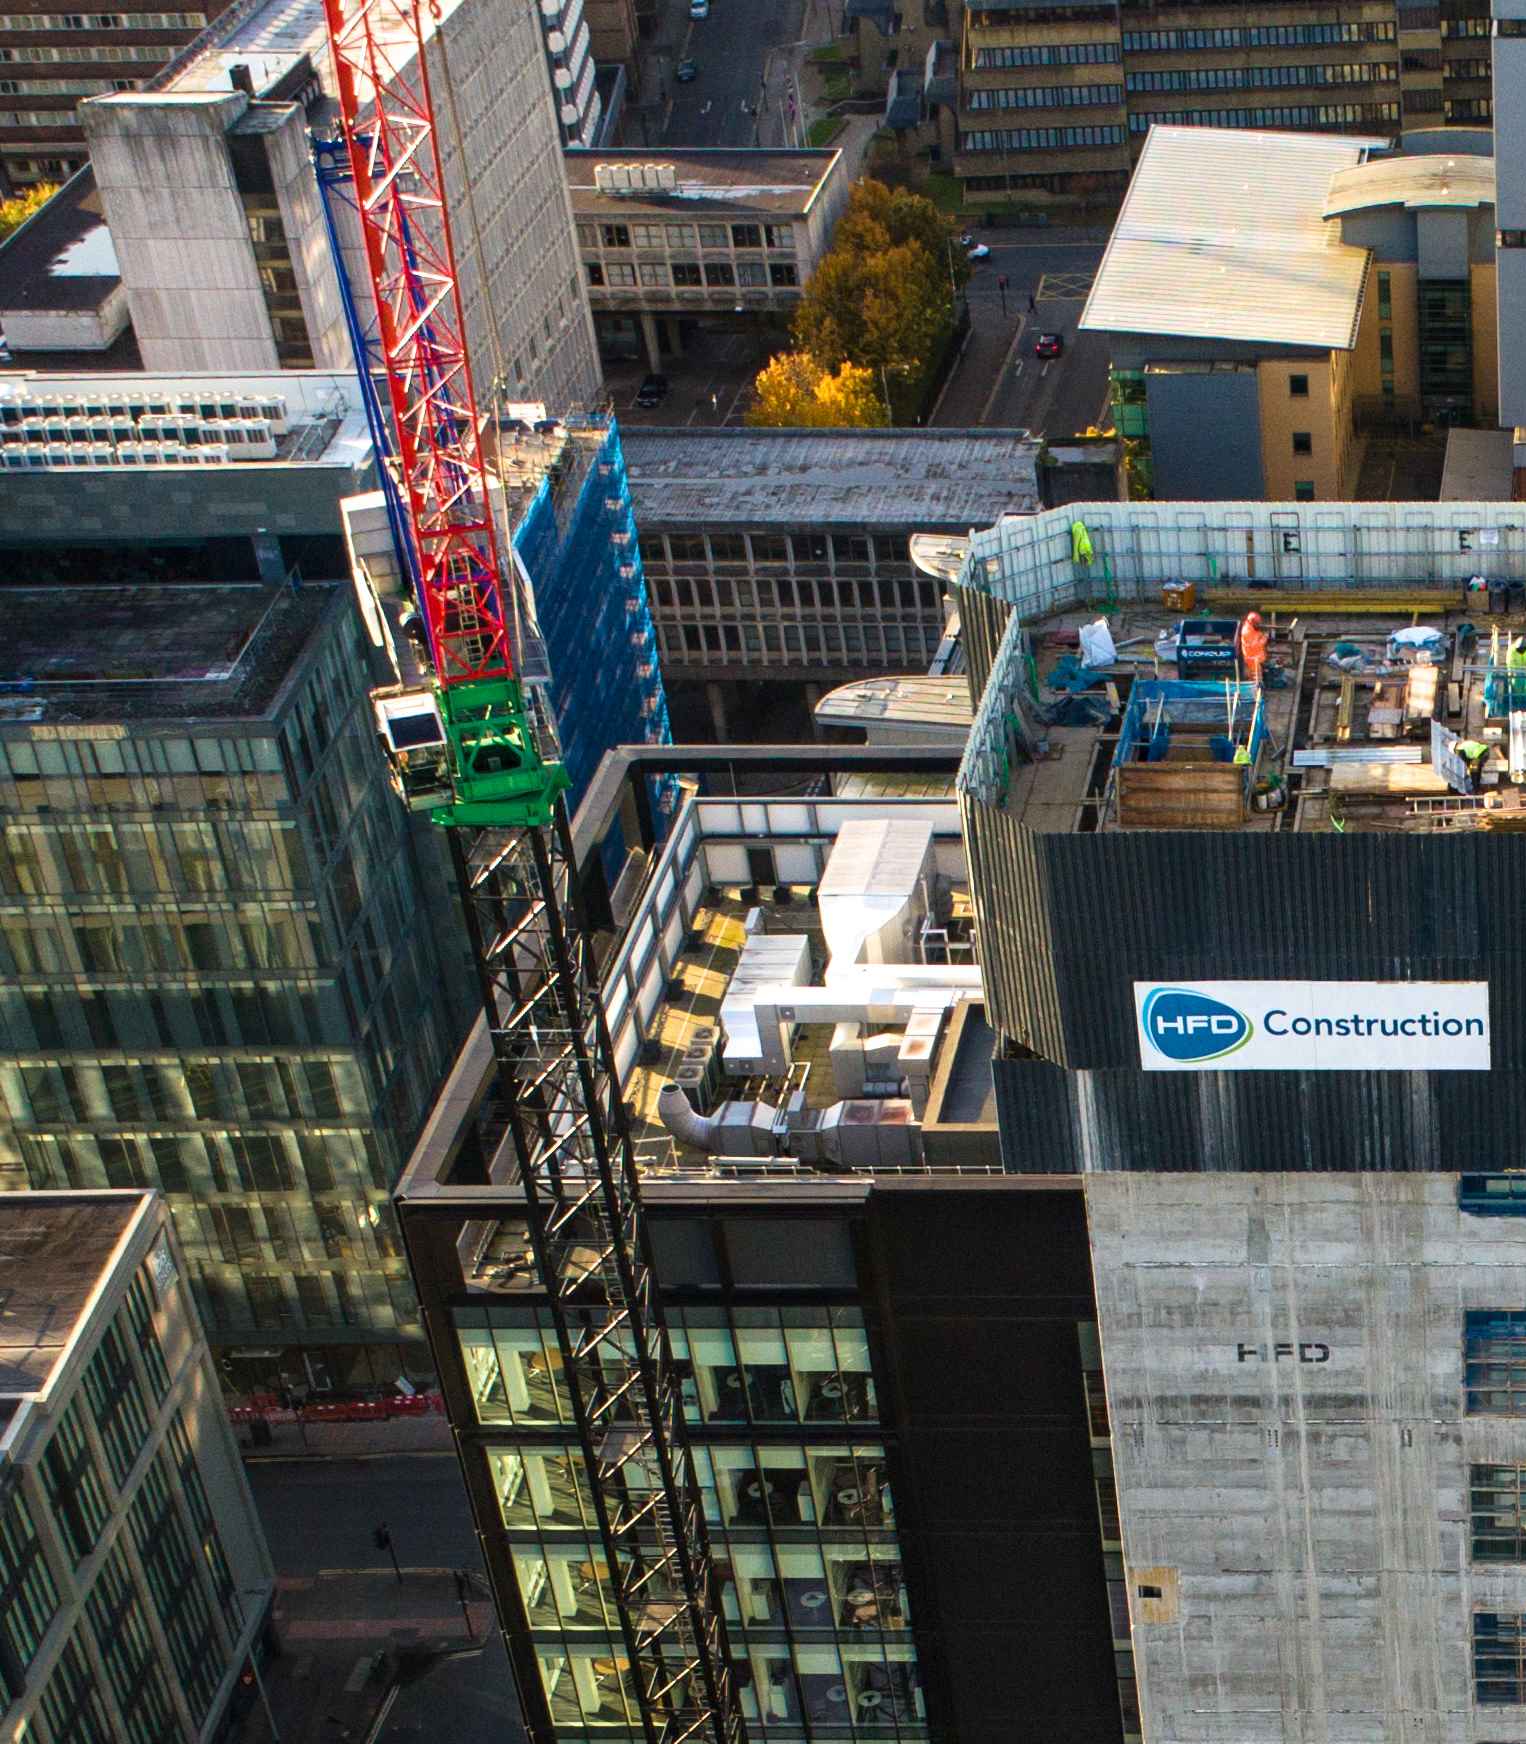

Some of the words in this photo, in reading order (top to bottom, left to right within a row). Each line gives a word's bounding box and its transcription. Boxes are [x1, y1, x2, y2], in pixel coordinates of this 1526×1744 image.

[1156, 1014, 1239, 1035] HFD
[1263, 1009, 1484, 1036] Construction
[1237, 1343, 1330, 1363] HFD
